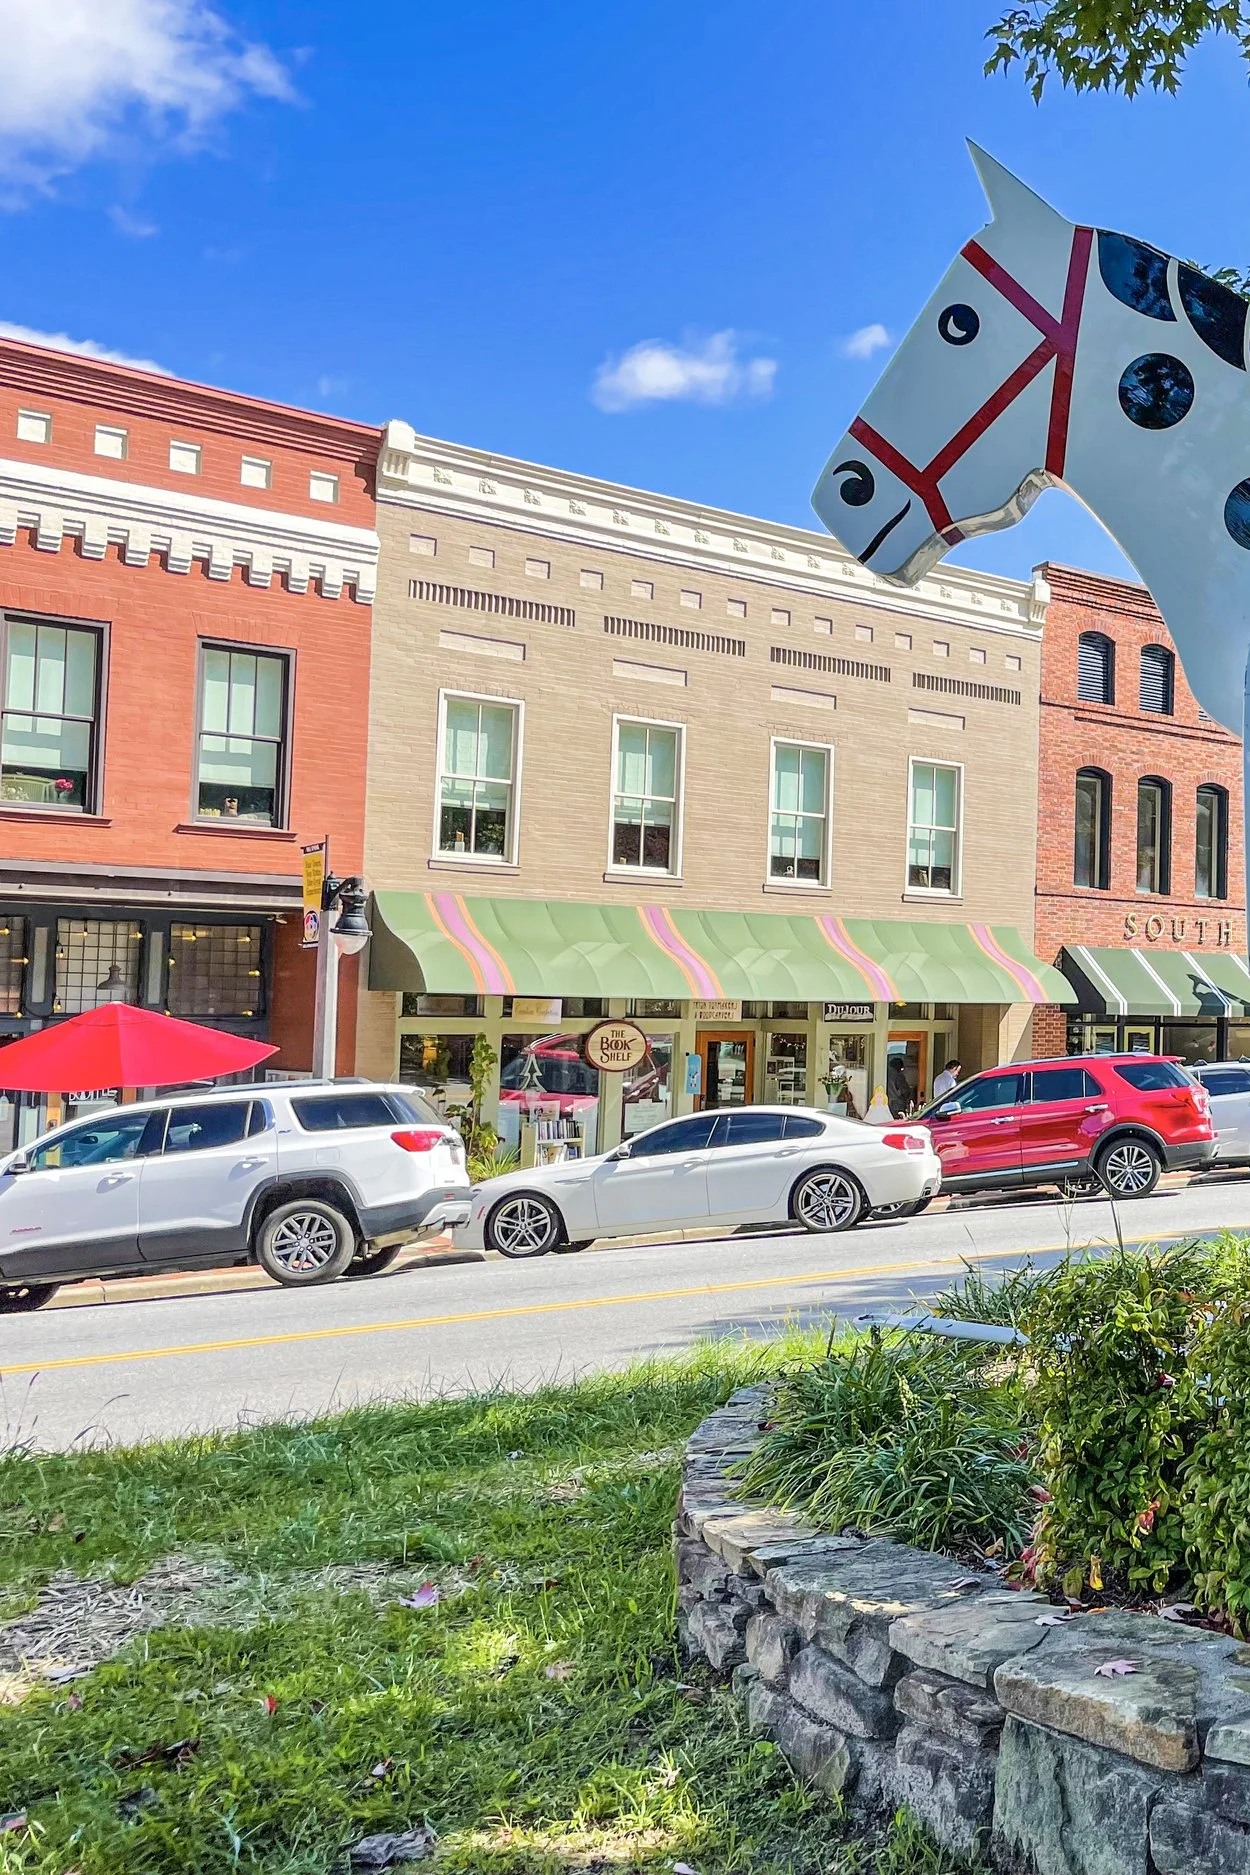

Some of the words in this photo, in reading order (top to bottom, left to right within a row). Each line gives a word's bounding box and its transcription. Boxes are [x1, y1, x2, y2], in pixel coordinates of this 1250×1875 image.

[1125, 913, 1234, 943] SOUTH
[611, 1030, 626, 1039] THE
[600, 1037, 638, 1051] BOOK
[600, 1049, 632, 1064] SHELF
